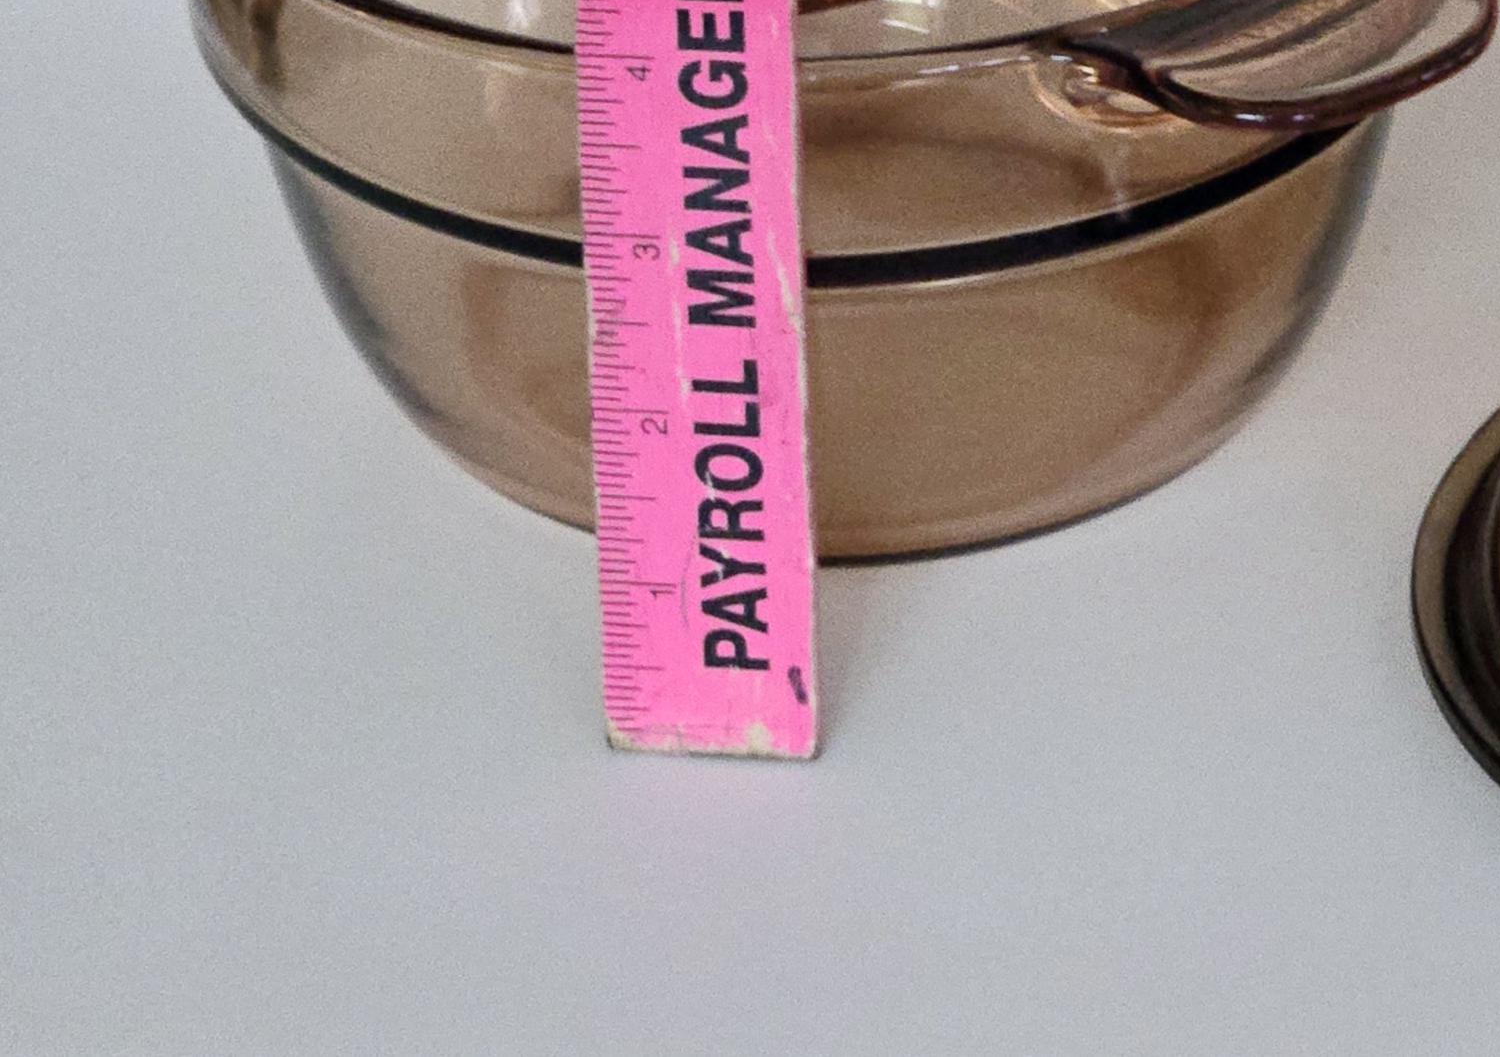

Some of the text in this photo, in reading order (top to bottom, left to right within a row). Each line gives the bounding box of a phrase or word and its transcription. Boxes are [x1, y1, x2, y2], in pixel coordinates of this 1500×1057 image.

[626, 65, 652, 82] 4
[633, 242, 661, 260] 3
[641, 417, 669, 436] 2
[691, 359, 770, 672] PAYROLL
[650, 589, 674, 602] 1
